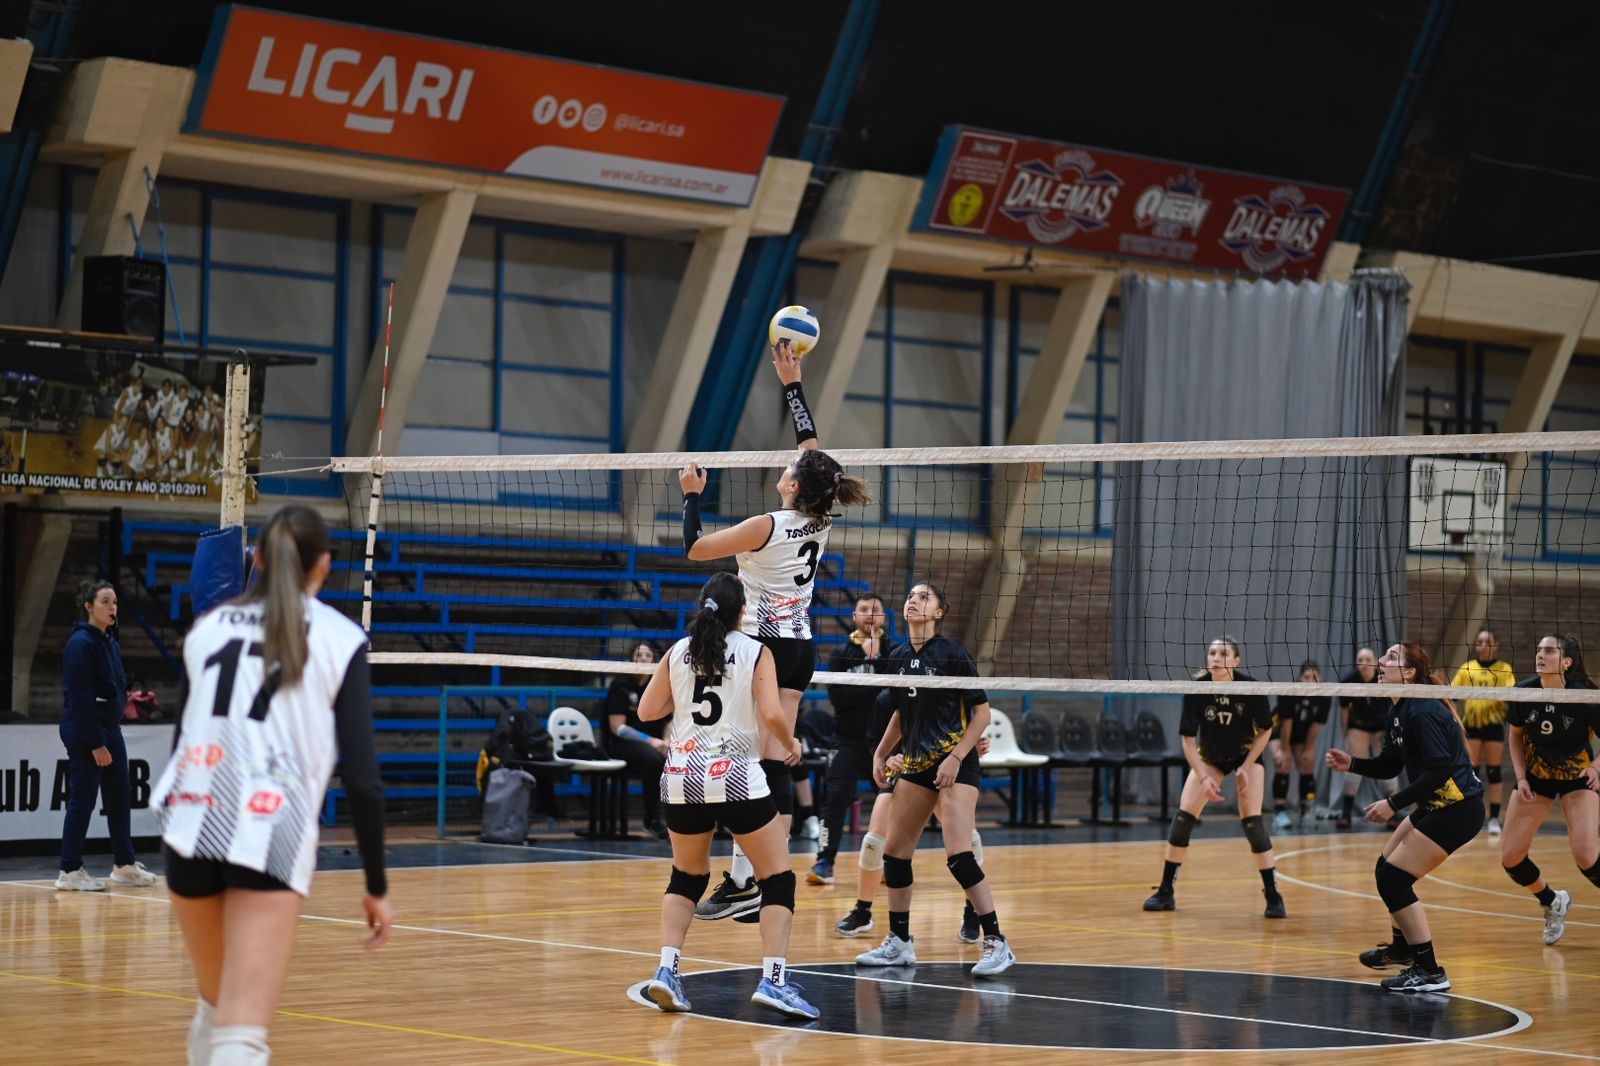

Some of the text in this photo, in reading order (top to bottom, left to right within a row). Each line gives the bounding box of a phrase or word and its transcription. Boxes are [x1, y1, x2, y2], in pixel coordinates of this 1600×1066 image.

[247, 36, 475, 134] LICARI
[1006, 172, 1119, 220] DALEMAS
[1225, 207, 1325, 250] DALEMAS
[1, 473, 207, 496] LIGA NACIONAL DE VOLEY AÑO 2010/2011
[794, 541, 820, 587] 3
[203, 638, 282, 722] 17
[691, 675, 723, 726] 5
[1217, 711, 1233, 726] 17
[1540, 720, 1553, 735] 9
